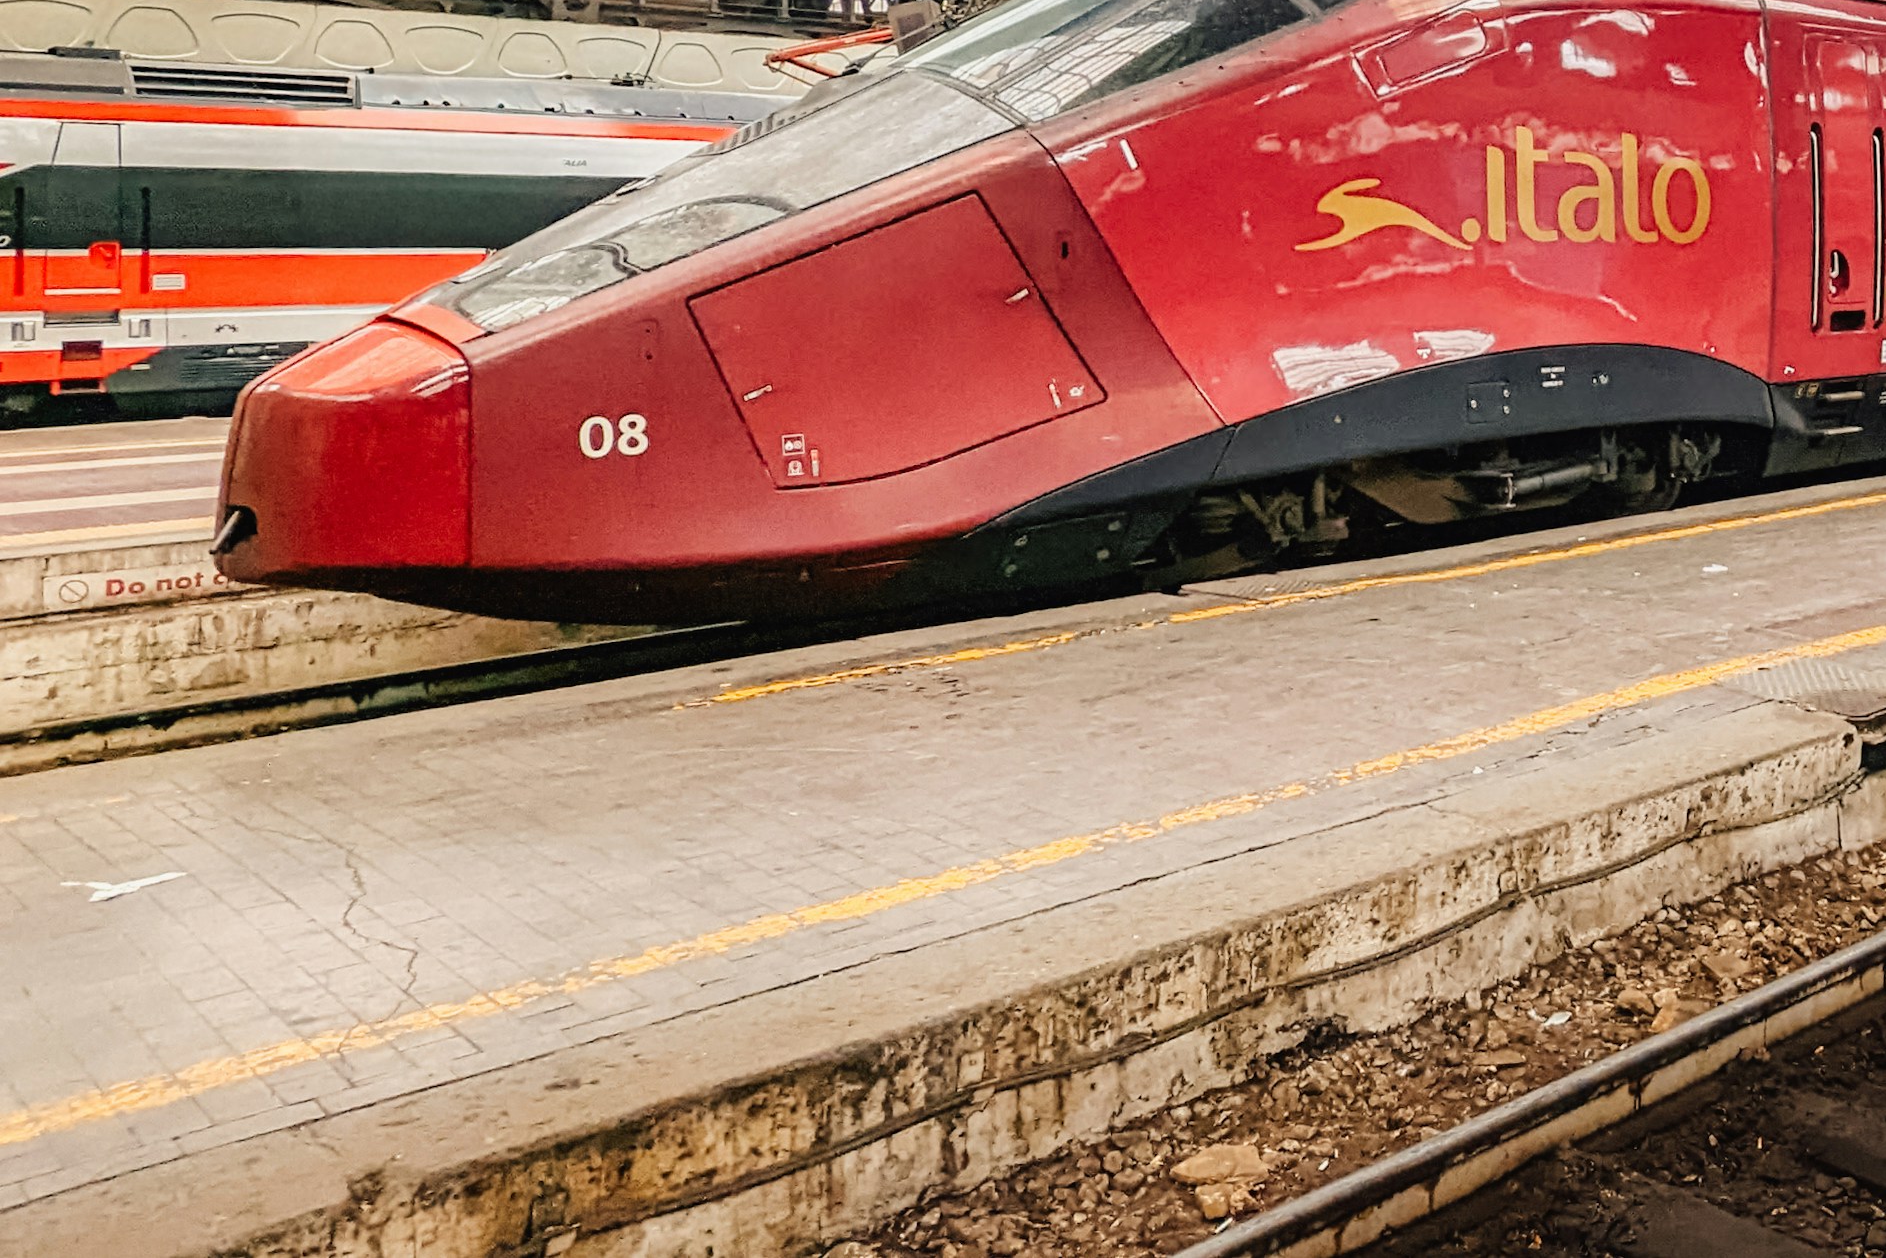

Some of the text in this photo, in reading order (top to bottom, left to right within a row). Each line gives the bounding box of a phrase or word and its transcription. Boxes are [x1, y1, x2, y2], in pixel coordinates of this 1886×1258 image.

[579, 413, 649, 459] 08
[105, 579, 146, 596] Do
[156, 572, 204, 591] not
